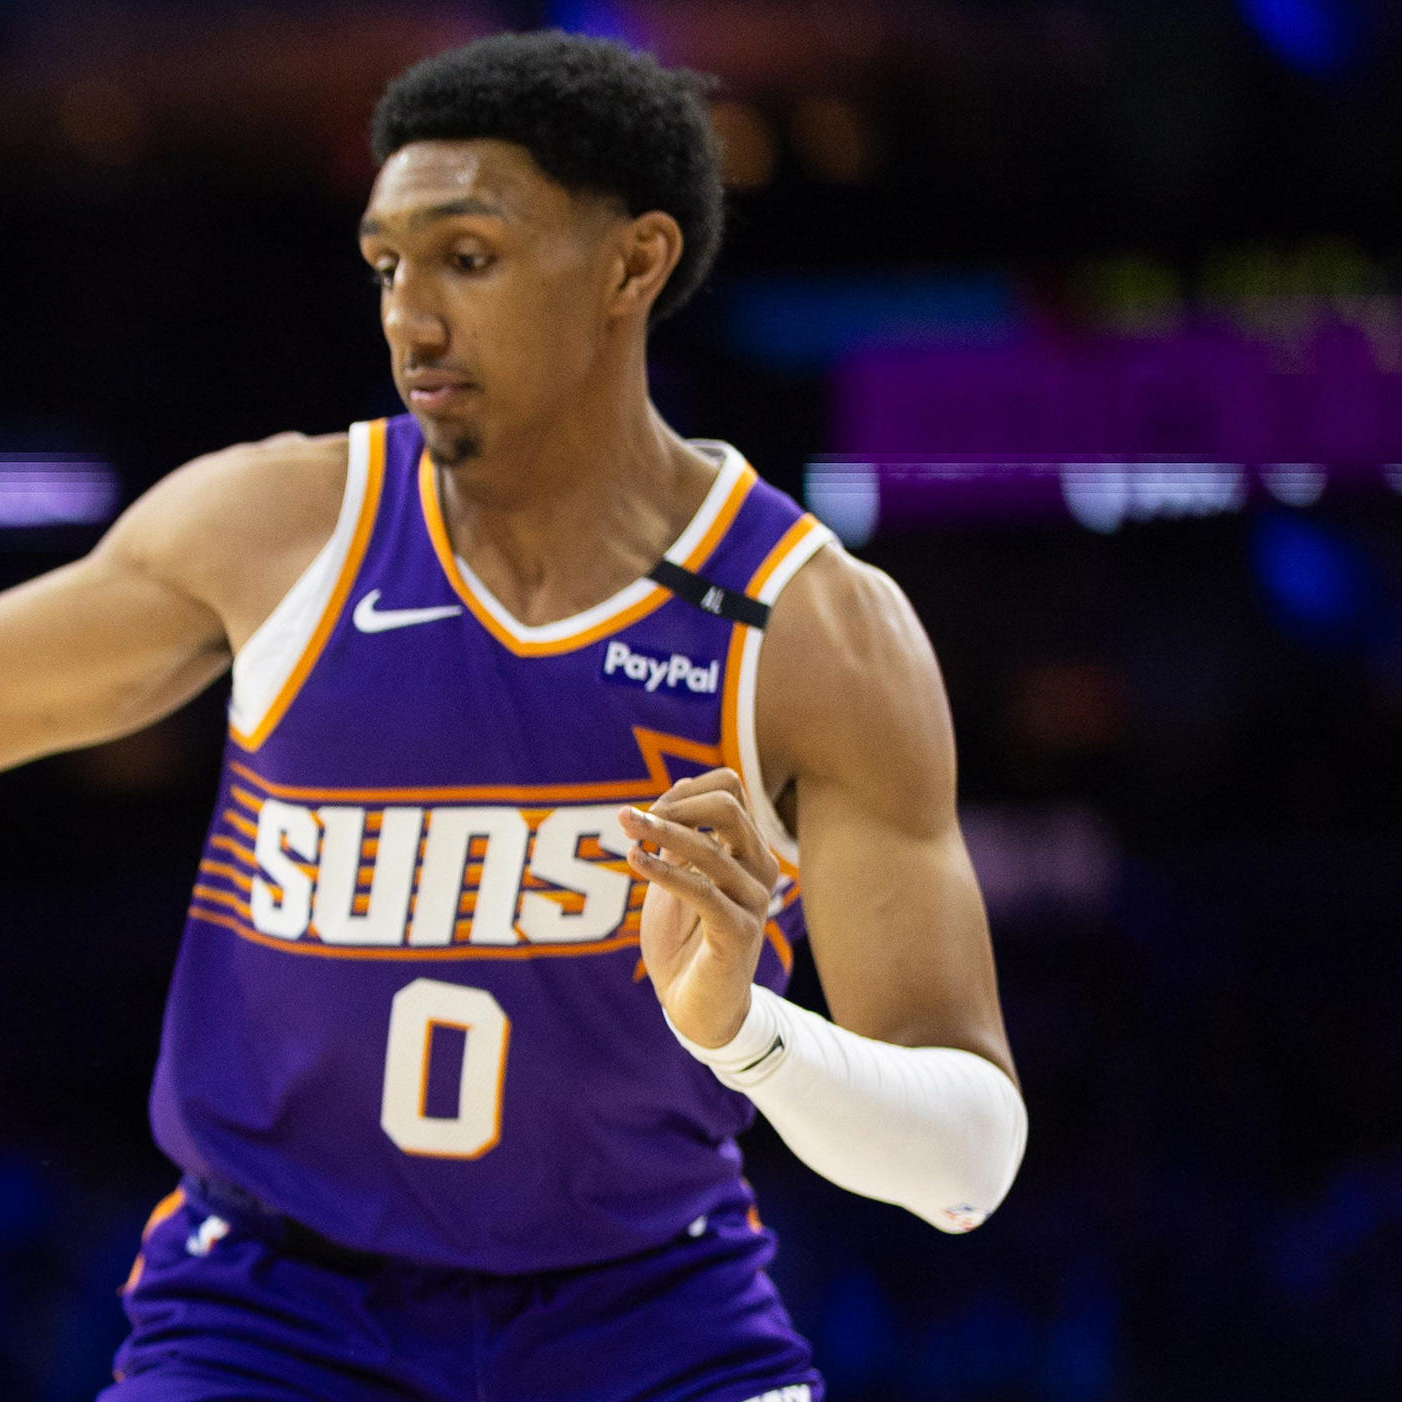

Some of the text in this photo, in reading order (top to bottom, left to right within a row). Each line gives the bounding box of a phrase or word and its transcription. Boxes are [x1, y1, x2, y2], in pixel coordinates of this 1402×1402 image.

[604, 641, 719, 694] PayPal
[249, 799, 638, 946] SUNS
[381, 977, 510, 1159] 0
